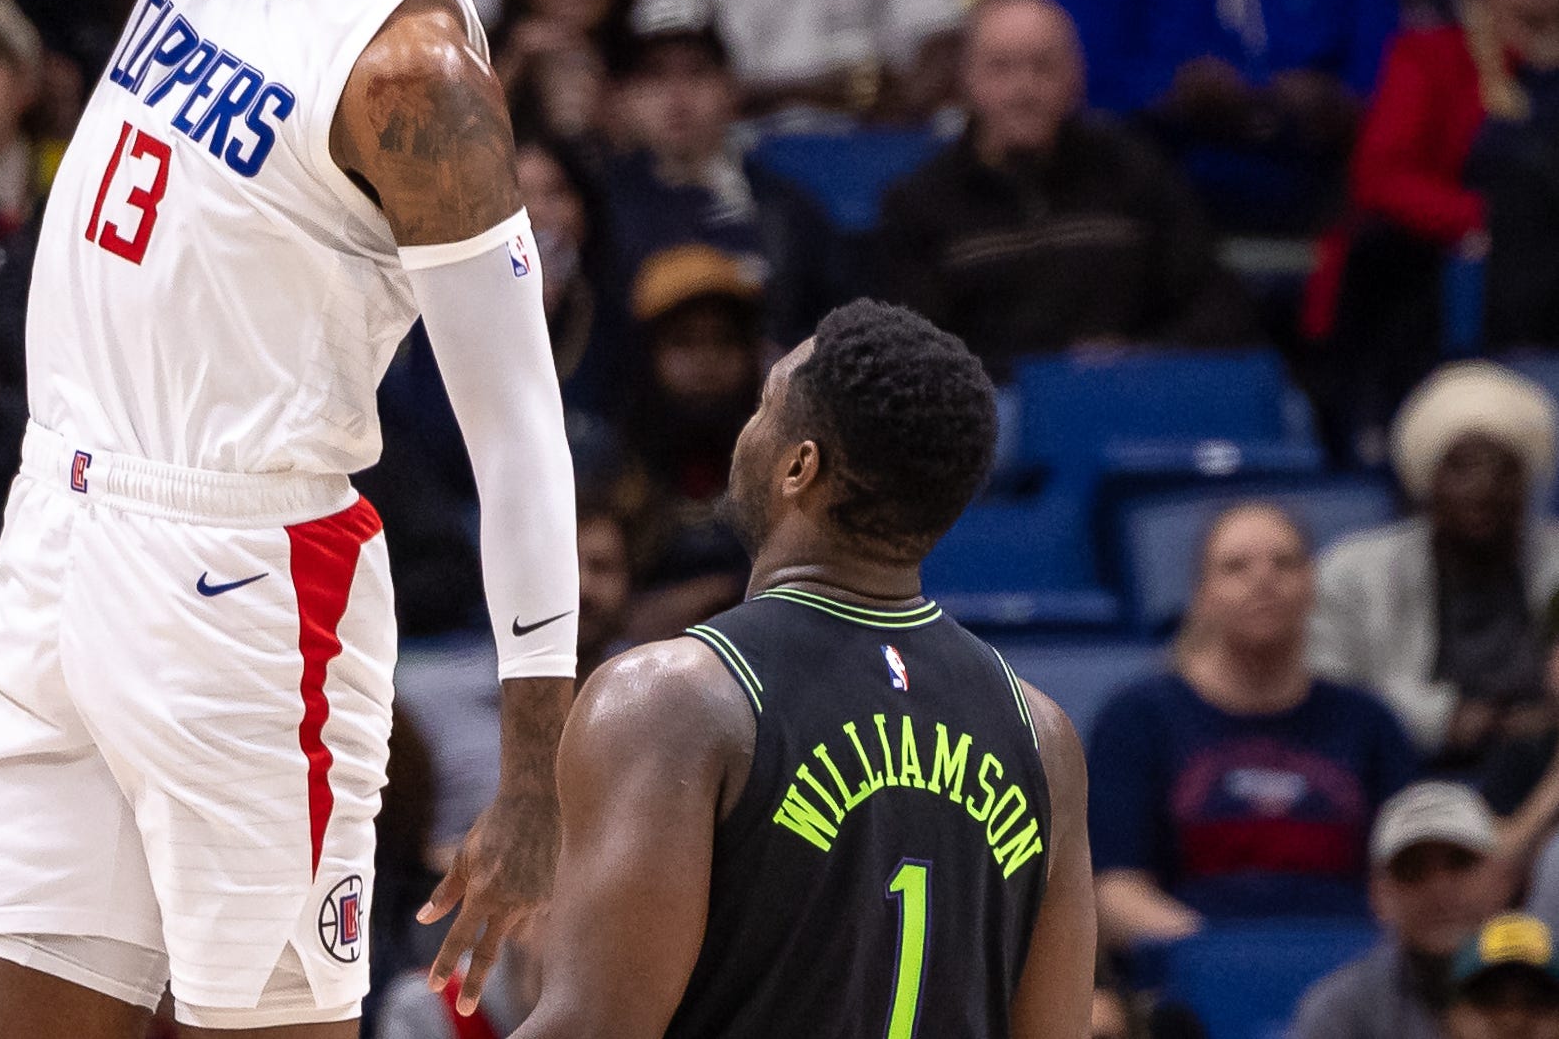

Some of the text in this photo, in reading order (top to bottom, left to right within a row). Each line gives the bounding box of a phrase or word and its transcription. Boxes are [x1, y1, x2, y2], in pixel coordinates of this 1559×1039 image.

[85, 120, 172, 267] 13
[772, 713, 1043, 880] WILLIAMSON
[885, 857, 933, 1039] 1
